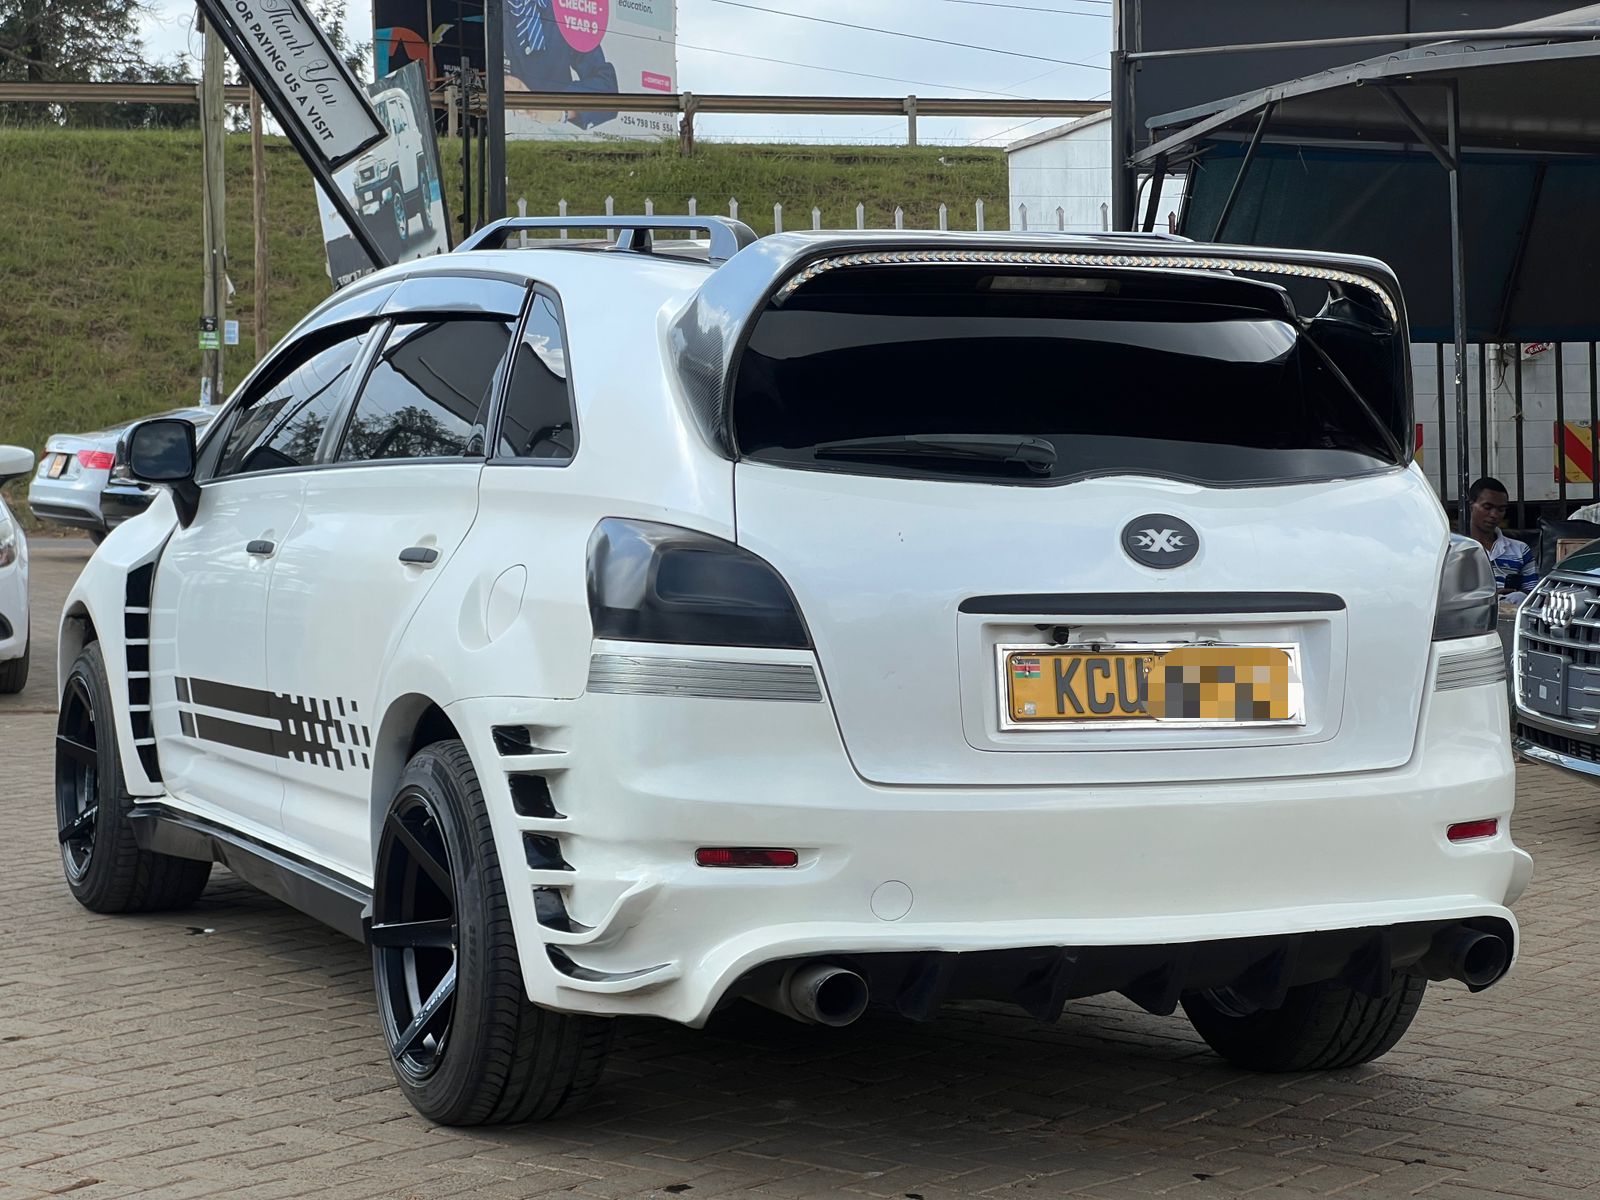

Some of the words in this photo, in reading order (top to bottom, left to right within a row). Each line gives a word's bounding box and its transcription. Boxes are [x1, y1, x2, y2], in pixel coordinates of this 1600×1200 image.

[618, 0, 653, 14] education.
[564, 15, 590, 33] YEAR
[592, 21, 599, 34] 9
[234, 0, 254, 23] OR
[250, 22, 287, 72] PAYING
[284, 73, 301, 93] US
[296, 96, 308, 107] A
[307, 106, 334, 140] VISIT
[298, 59, 338, 107] You
